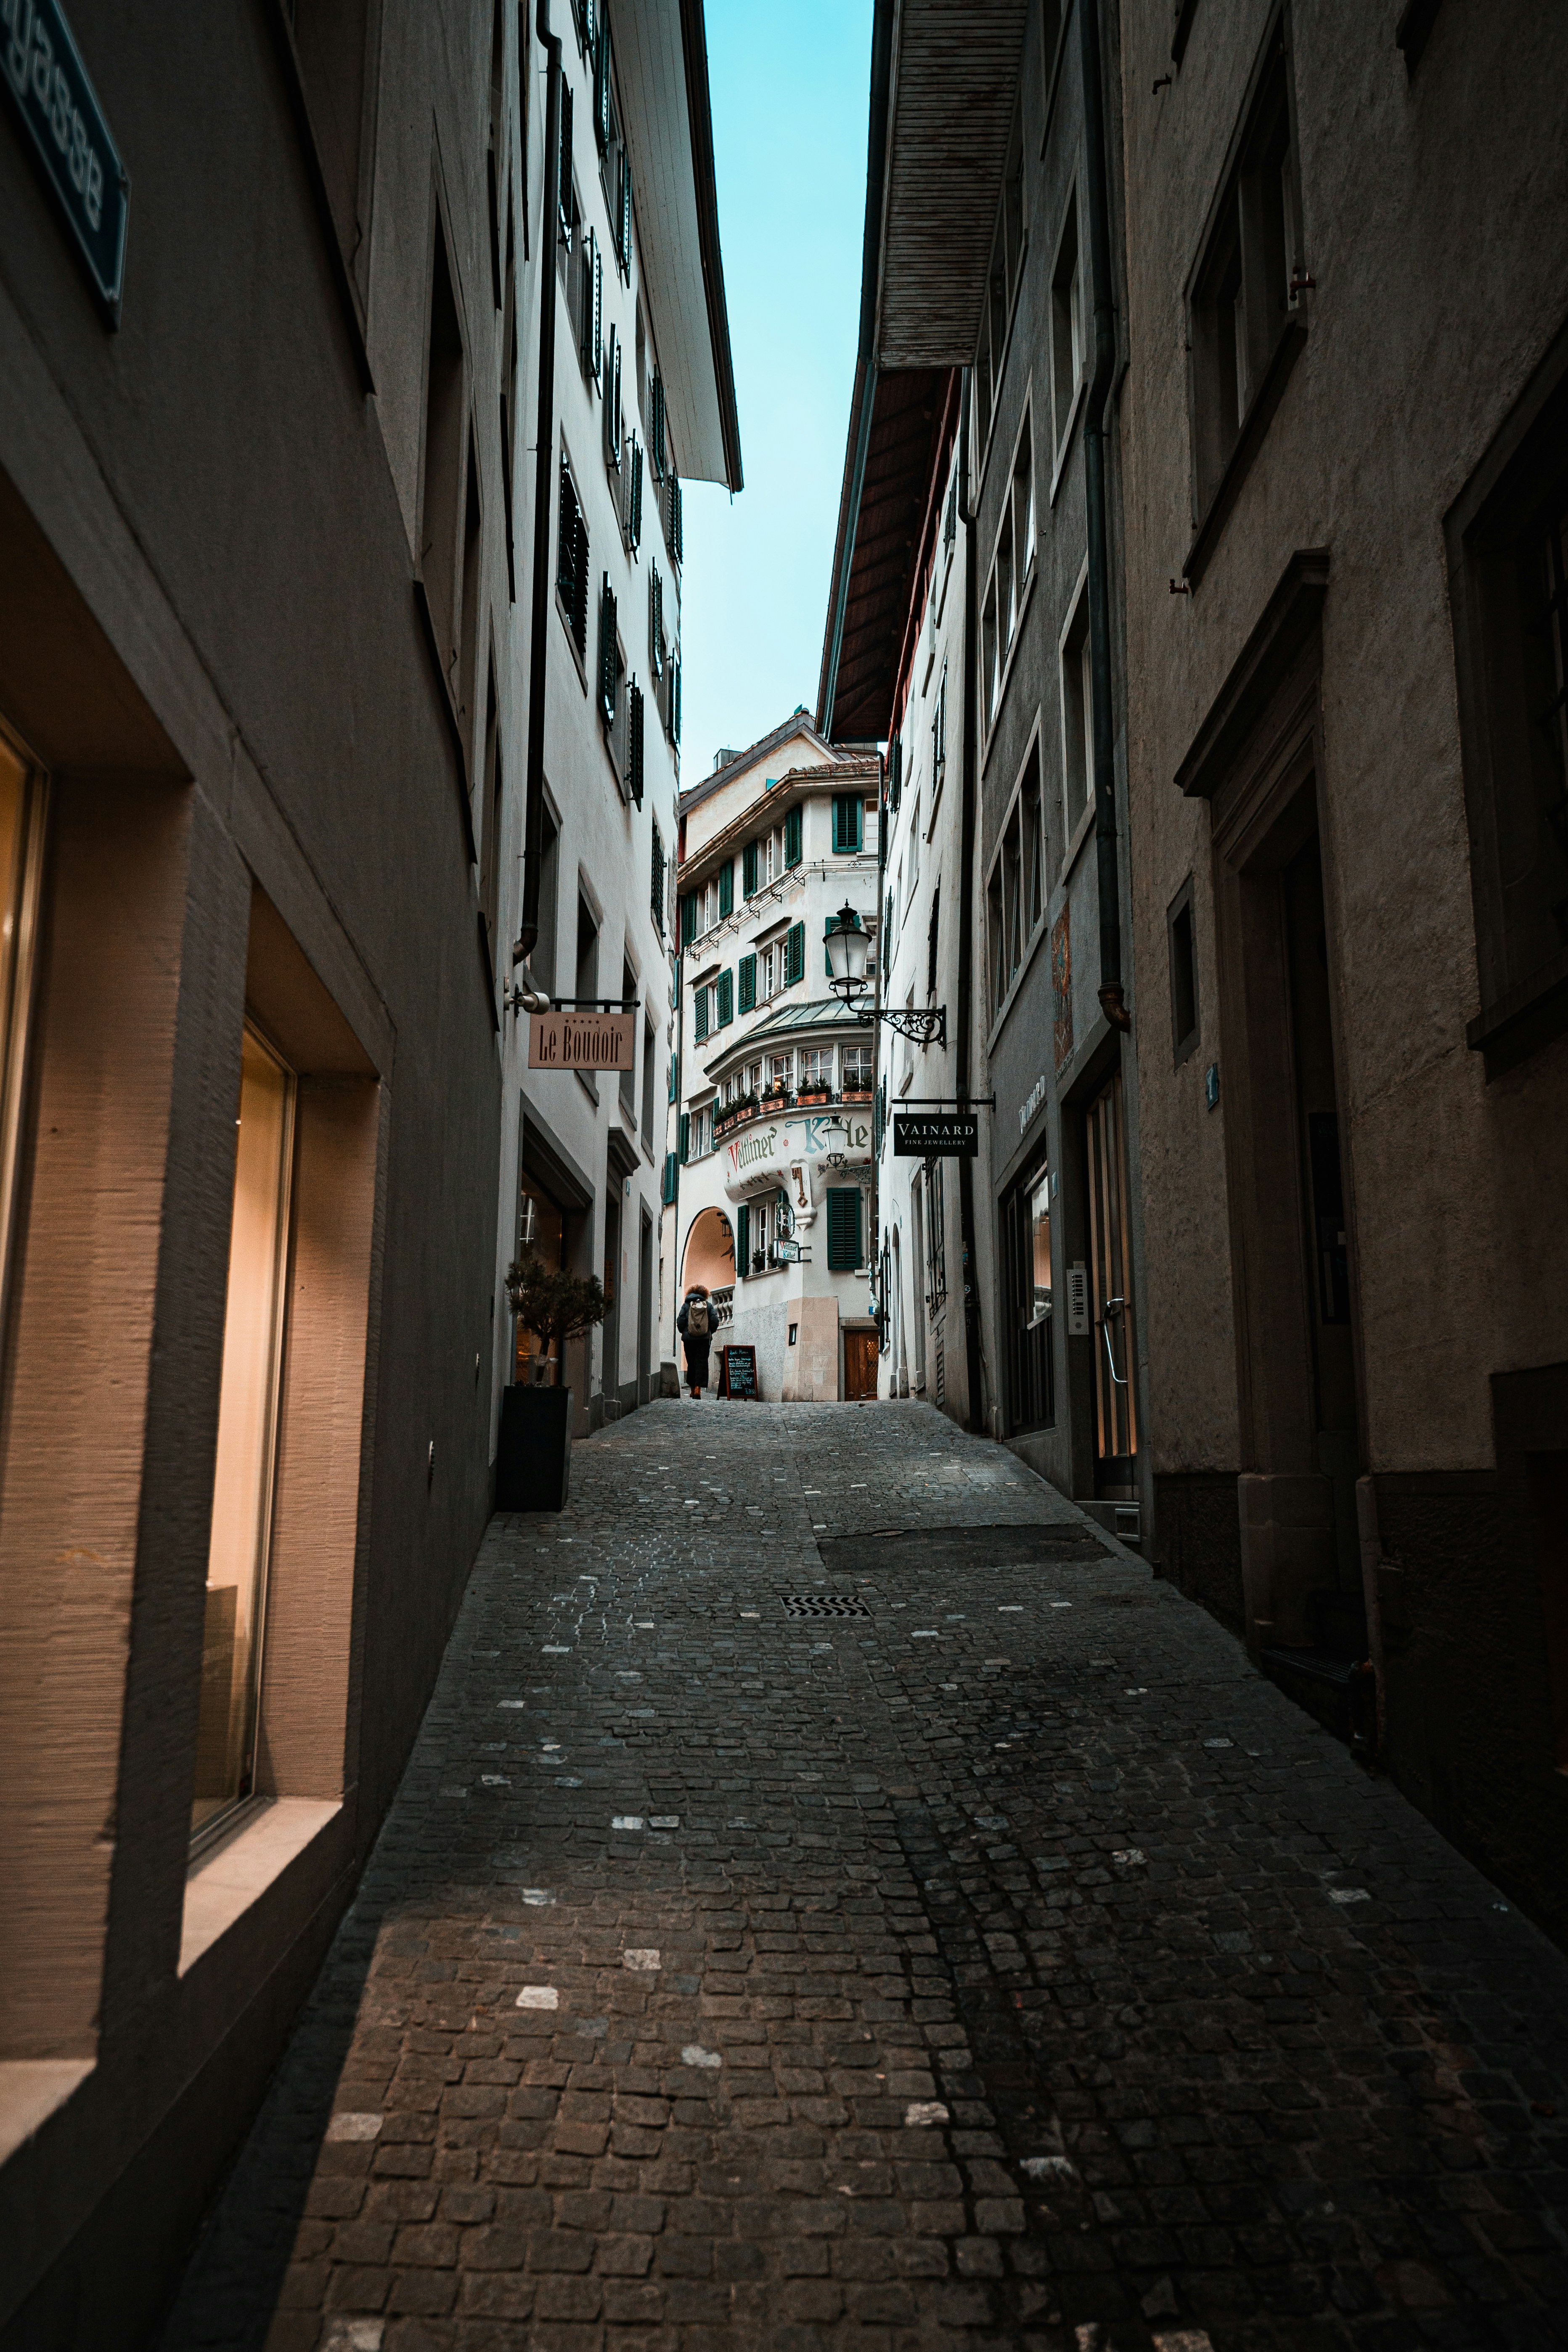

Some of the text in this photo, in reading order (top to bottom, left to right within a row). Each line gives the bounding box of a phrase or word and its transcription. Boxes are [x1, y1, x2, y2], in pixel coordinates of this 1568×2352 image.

[540, 1025, 622, 1063] Le Boudoir
[728, 1126, 777, 1171] Veltliner
[779, 1240, 797, 1252] Veltliner
[780, 1249, 795, 1260] Keller
